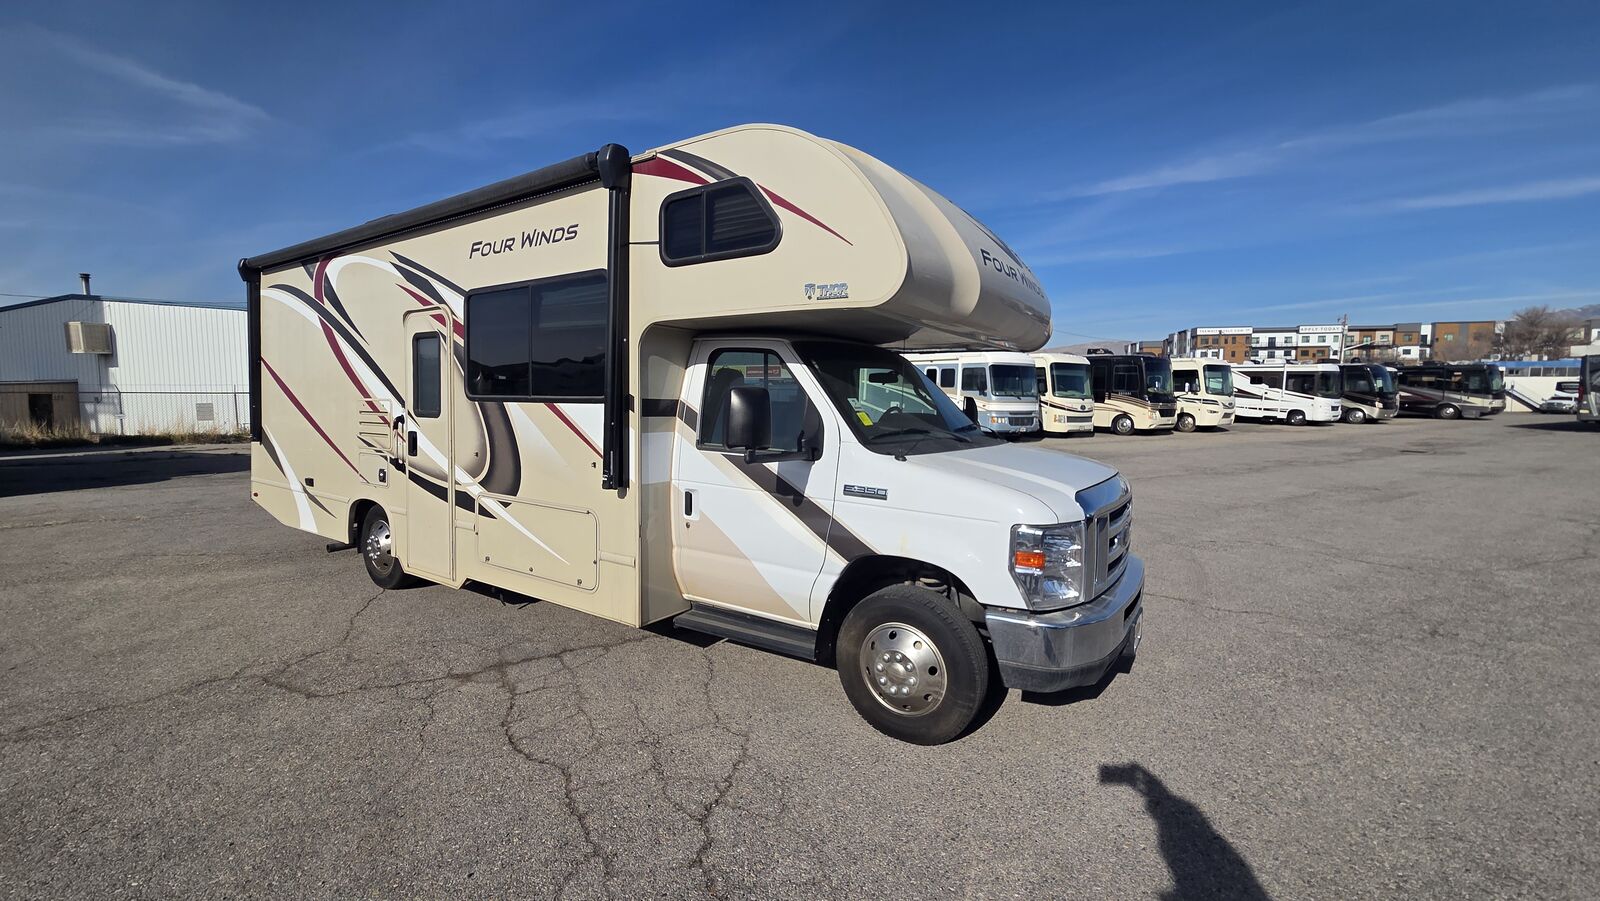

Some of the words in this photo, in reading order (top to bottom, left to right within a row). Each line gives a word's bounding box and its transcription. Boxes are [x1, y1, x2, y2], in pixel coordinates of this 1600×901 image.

[469, 237, 516, 259] FOUR
[521, 223, 579, 249] WINDS
[980, 248, 1018, 282] FOUR
[817, 283, 848, 297] THOR
